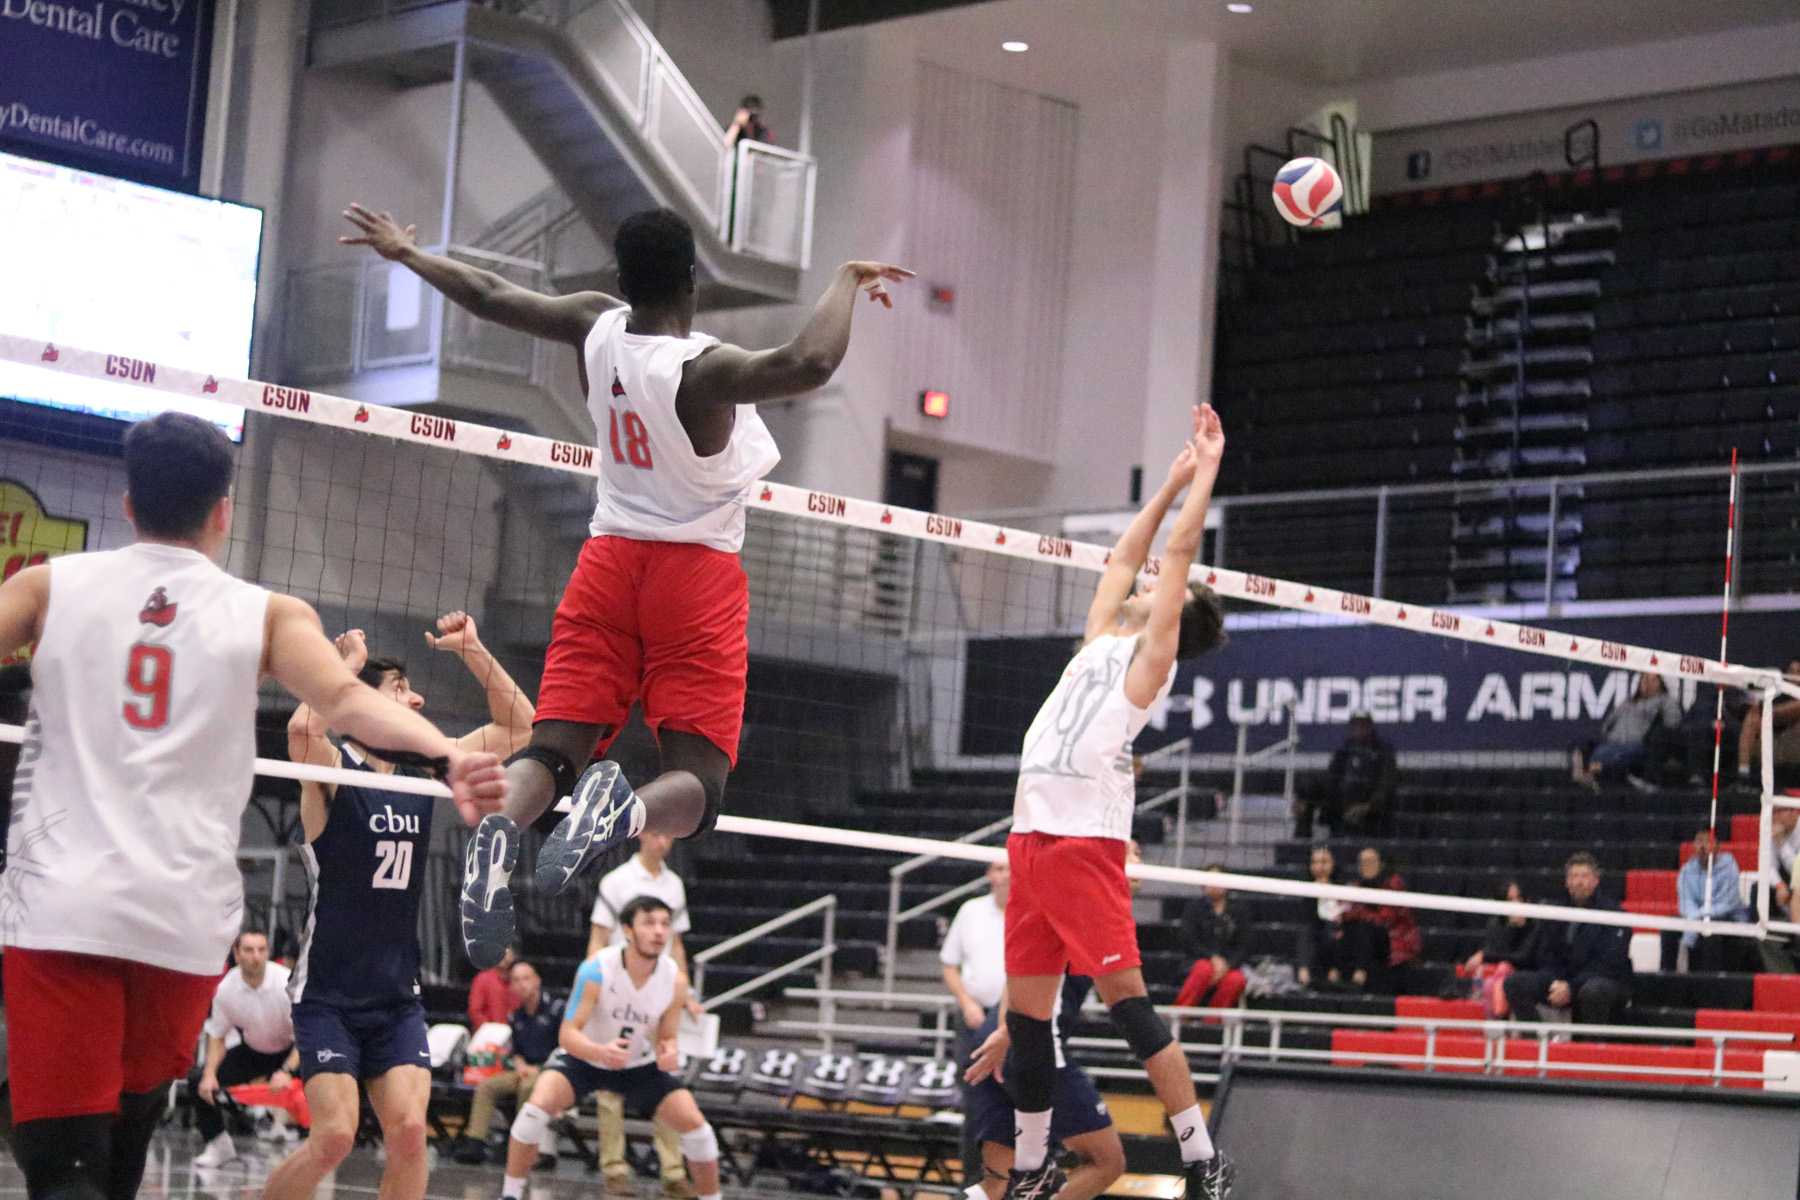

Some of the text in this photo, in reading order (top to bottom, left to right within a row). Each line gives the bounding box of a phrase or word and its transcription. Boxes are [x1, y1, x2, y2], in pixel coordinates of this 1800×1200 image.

[110, 9, 180, 58] Care
[105, 354, 156, 383] CSUN
[262, 385, 311, 413] CSUN
[410, 415, 456, 441] CSUN
[609, 405, 654, 471] 18
[551, 442, 593, 468] CSUN
[808, 493, 846, 518] CSUN
[926, 515, 962, 538] CSUN
[1038, 535, 1073, 558] CSUN
[1245, 575, 1276, 597] CSUN
[1341, 593, 1371, 615] CSUN
[1432, 611, 1460, 631] CSUN
[1518, 628, 1546, 647] CSUN
[1601, 641, 1627, 662] CSUN
[1680, 655, 1705, 674] CSUN
[122, 641, 175, 733] 9
[1227, 675, 1446, 724] UNDER
[369, 805, 420, 834] cbu
[372, 840, 414, 890] 20
